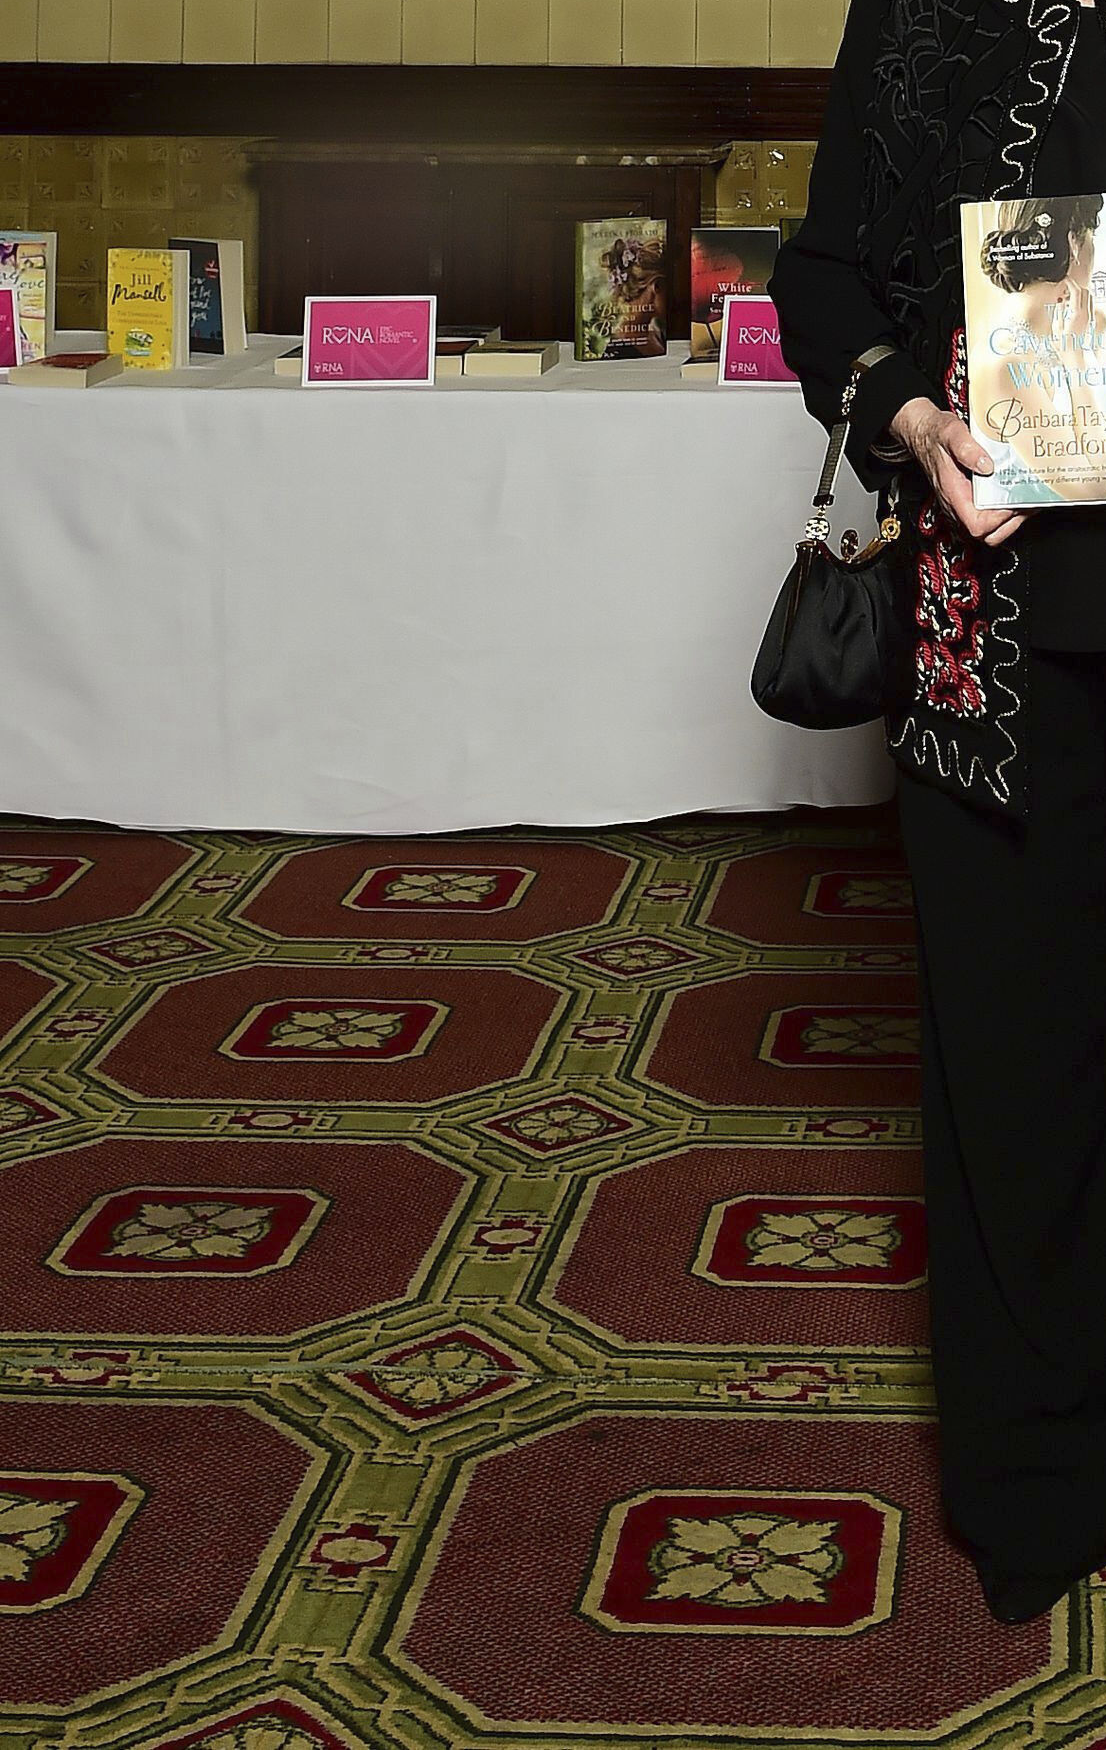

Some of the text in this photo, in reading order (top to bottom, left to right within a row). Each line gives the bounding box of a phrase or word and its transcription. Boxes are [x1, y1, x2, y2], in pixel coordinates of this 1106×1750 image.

[1040, 241, 1048, 250] of
[1016, 253, 1024, 261] of
[130, 273, 151, 288] Jill
[717, 282, 753, 293] White
[111, 282, 167, 306] Mansell
[598, 301, 655, 317] BEATRICE
[322, 362, 343, 372] RNA
[738, 363, 758, 373] RNA
[986, 397, 1077, 444] Barbara
